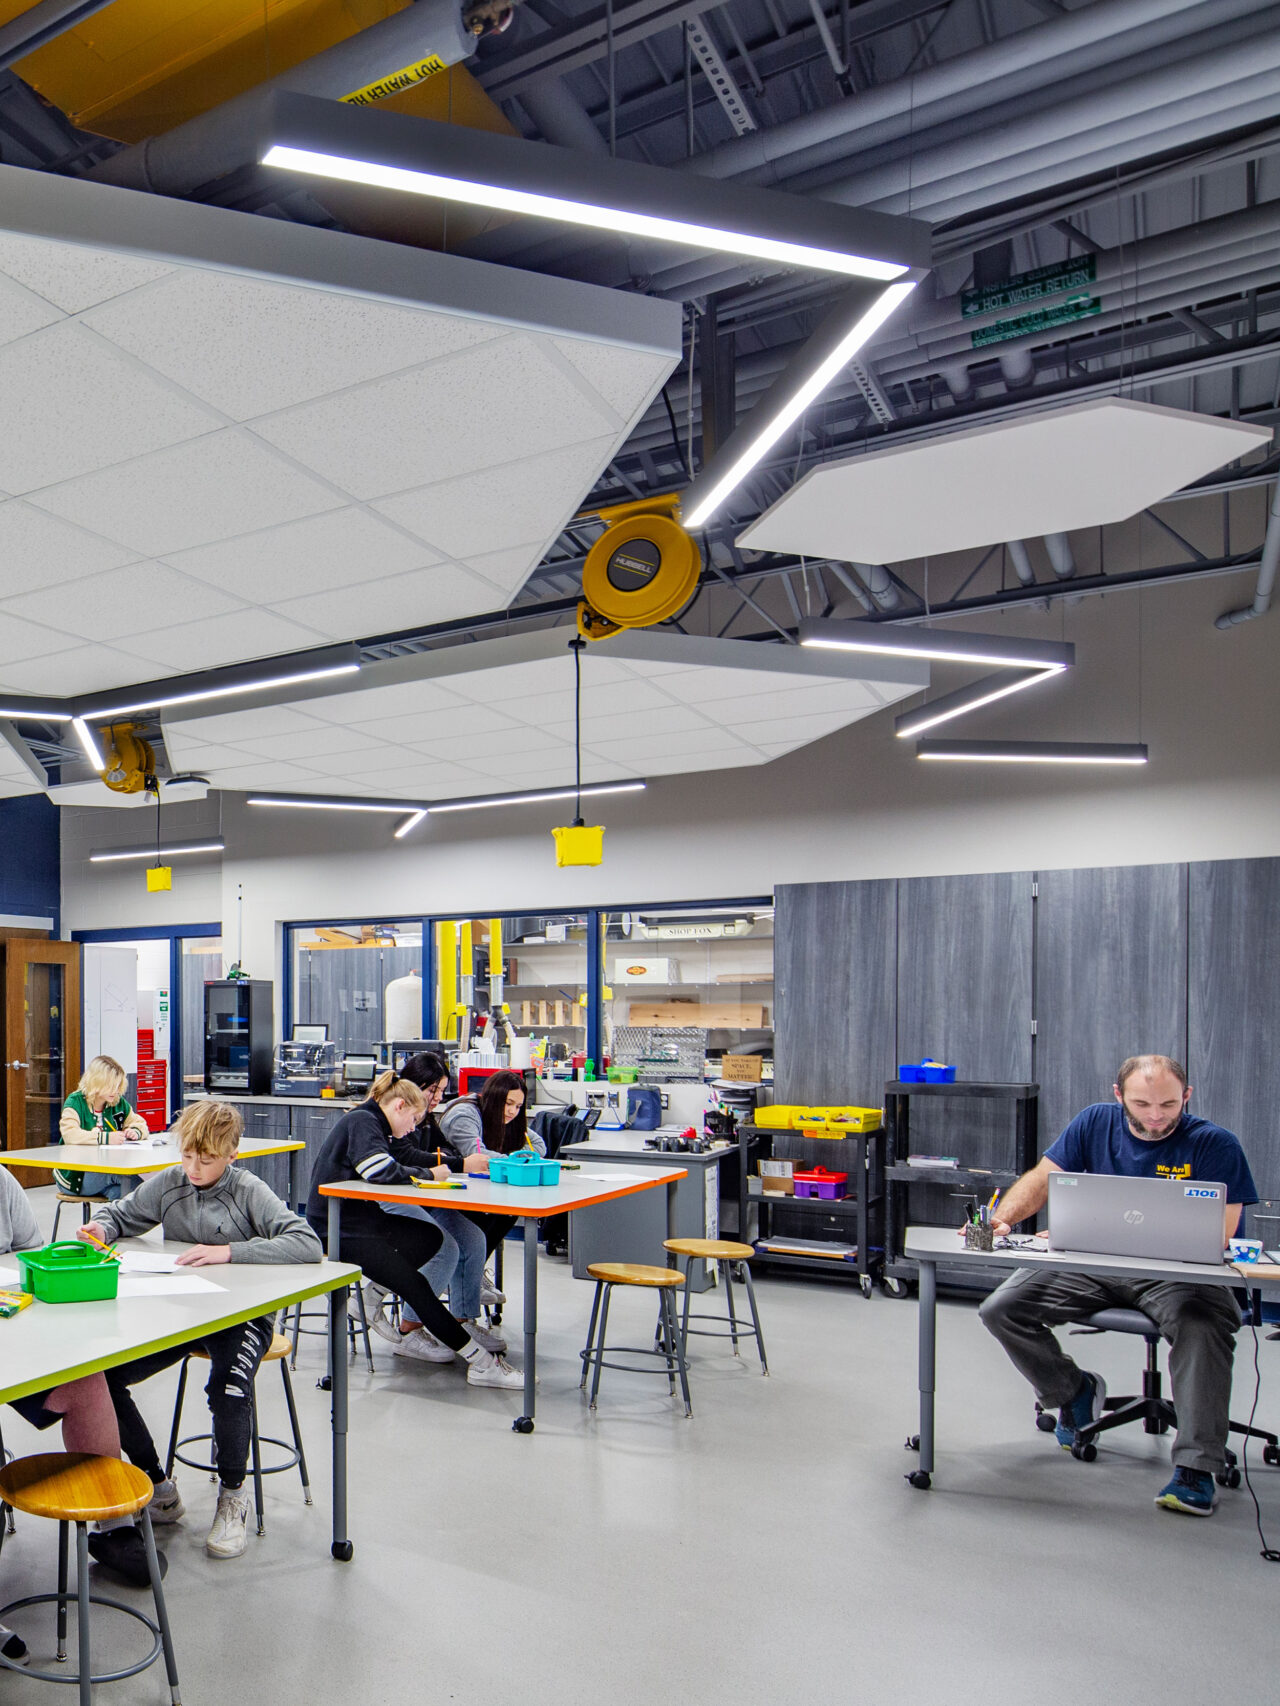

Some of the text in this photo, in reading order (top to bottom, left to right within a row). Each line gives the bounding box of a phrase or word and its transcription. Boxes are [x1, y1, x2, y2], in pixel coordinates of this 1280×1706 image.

[414, 59, 443, 78] HOT
[368, 73, 414, 100] WATER
[982, 268, 1091, 311] HOT WATER RETURN
[669, 928, 691, 936] SHOP
[1157, 1164, 1171, 1173] We
[1186, 1188, 1219, 1198] BOLT
[1125, 1210, 1144, 1224] hp
